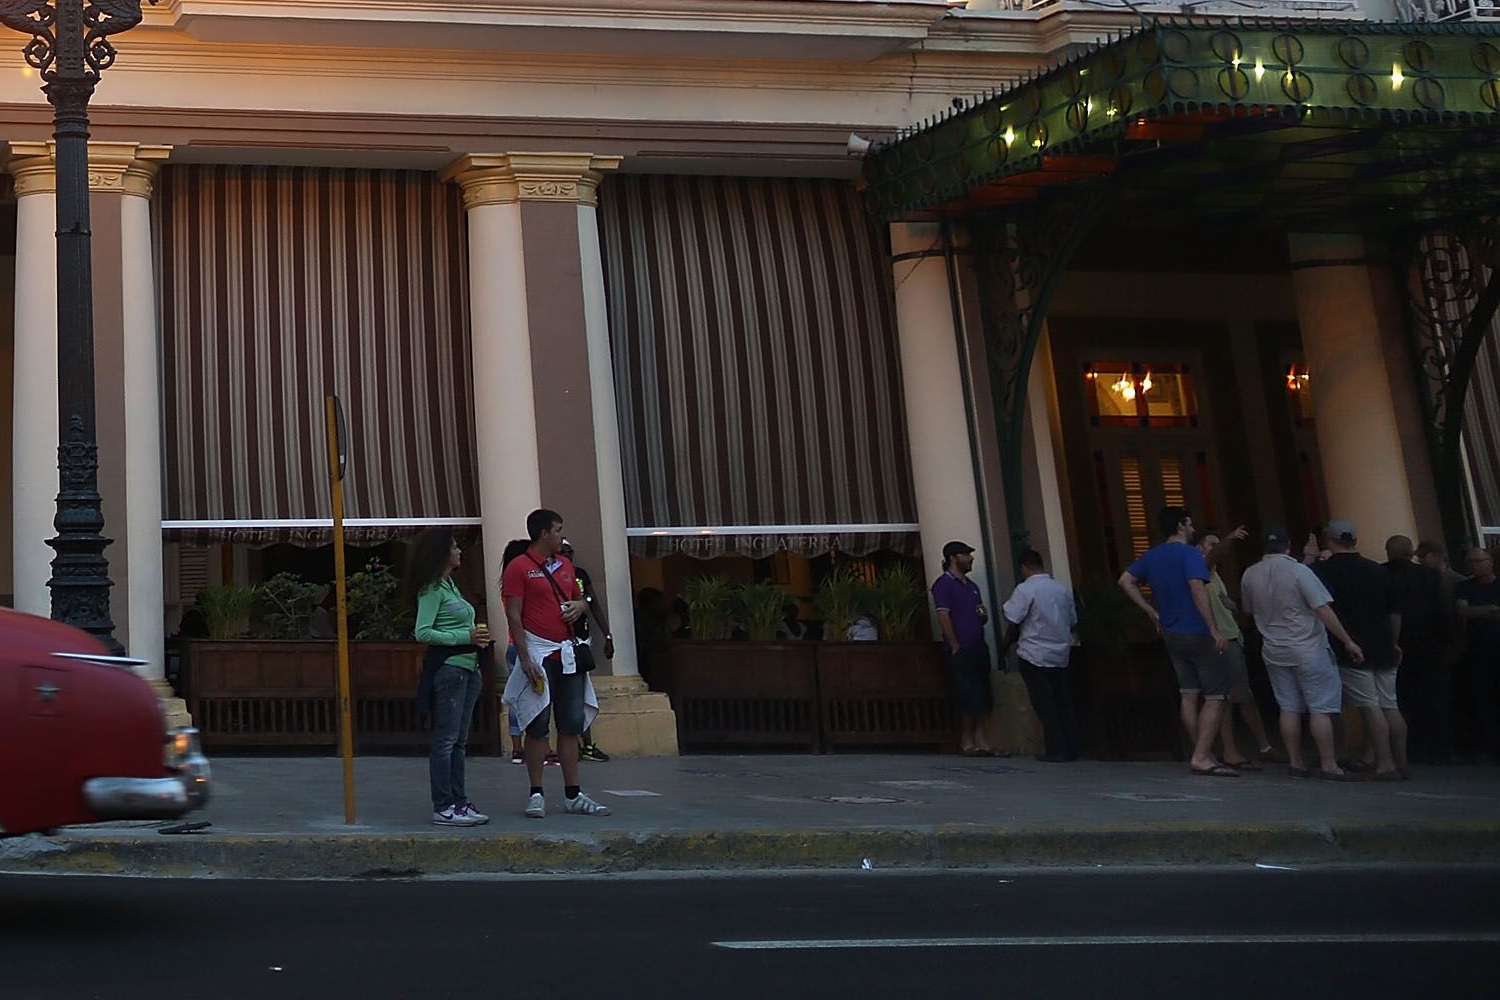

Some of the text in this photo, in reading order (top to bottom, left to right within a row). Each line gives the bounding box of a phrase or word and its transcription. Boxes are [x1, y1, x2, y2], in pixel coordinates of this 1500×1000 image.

[287, 530, 400, 543] INGLTERRA
[669, 536, 842, 551] HOTEL INGLATERRA
